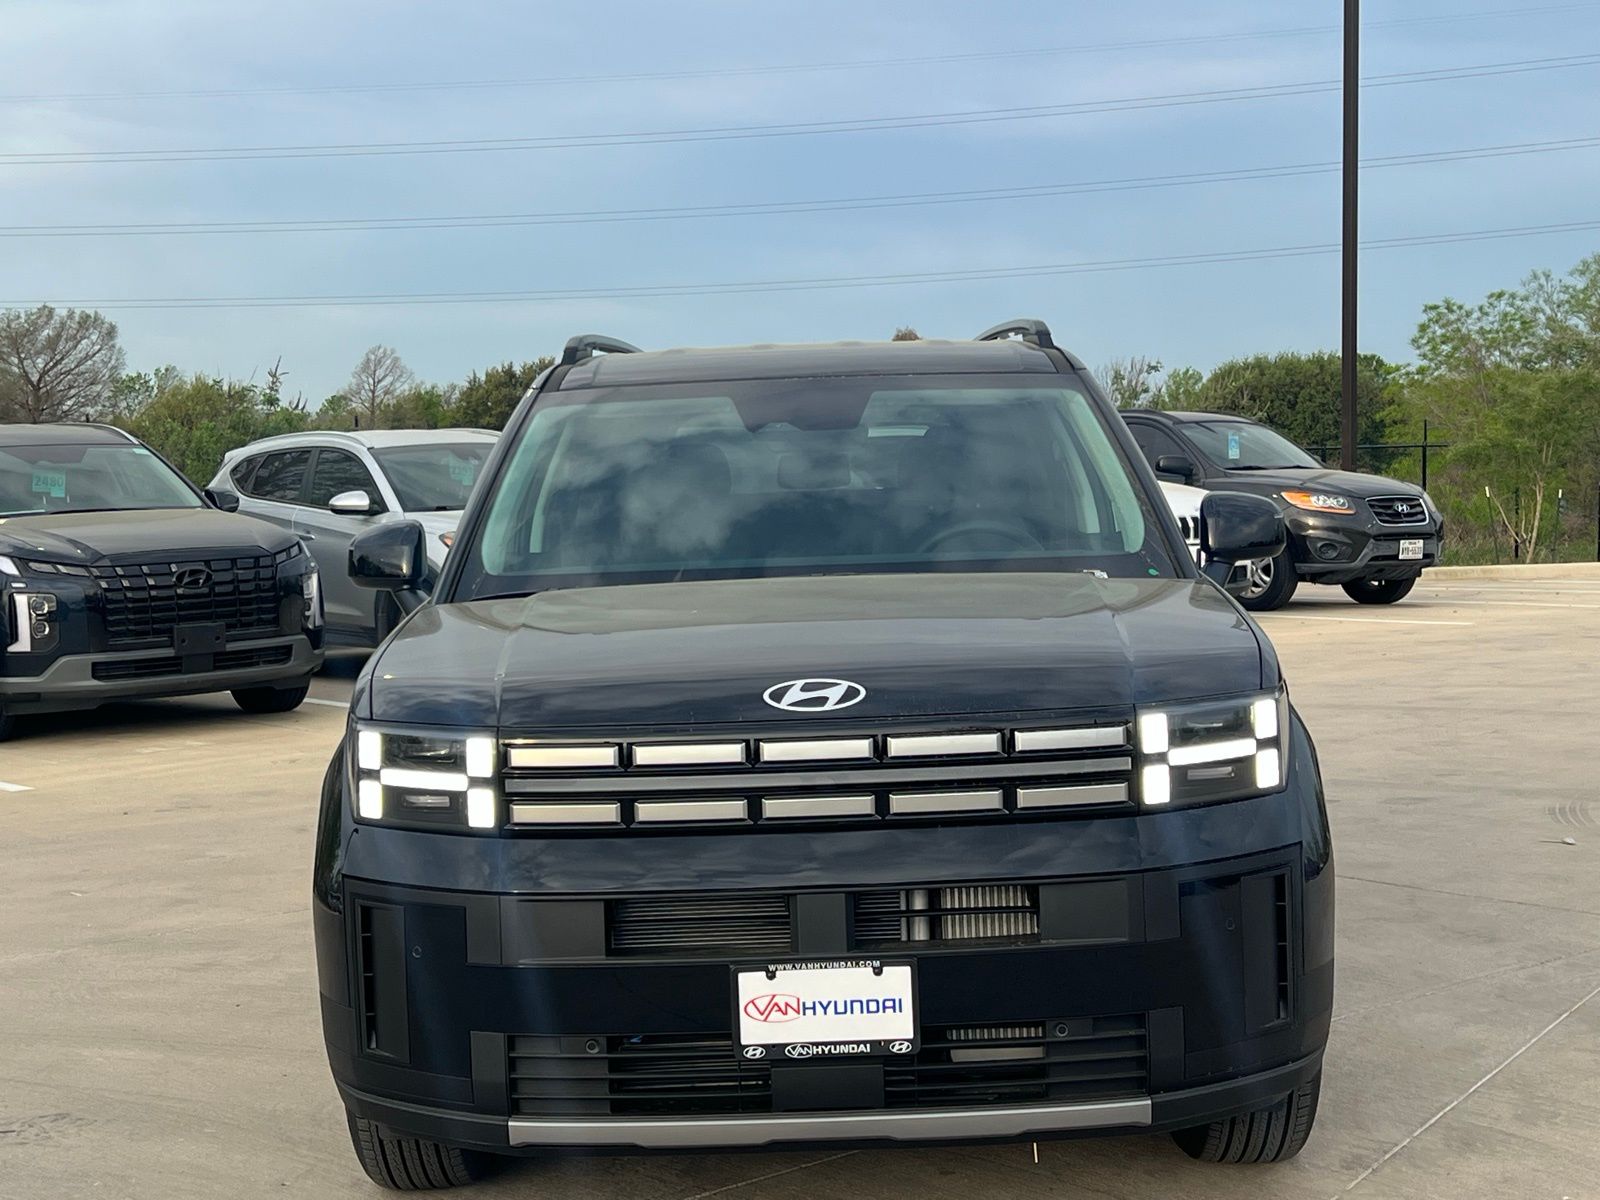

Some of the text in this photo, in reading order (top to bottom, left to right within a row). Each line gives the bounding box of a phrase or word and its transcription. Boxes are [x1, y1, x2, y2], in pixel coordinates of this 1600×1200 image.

[767, 960, 881, 972] WWW.VANHYUNDAI.COM
[802, 998, 903, 1016] HYUNDAI
[813, 1044, 871, 1054] HYUNDAI
